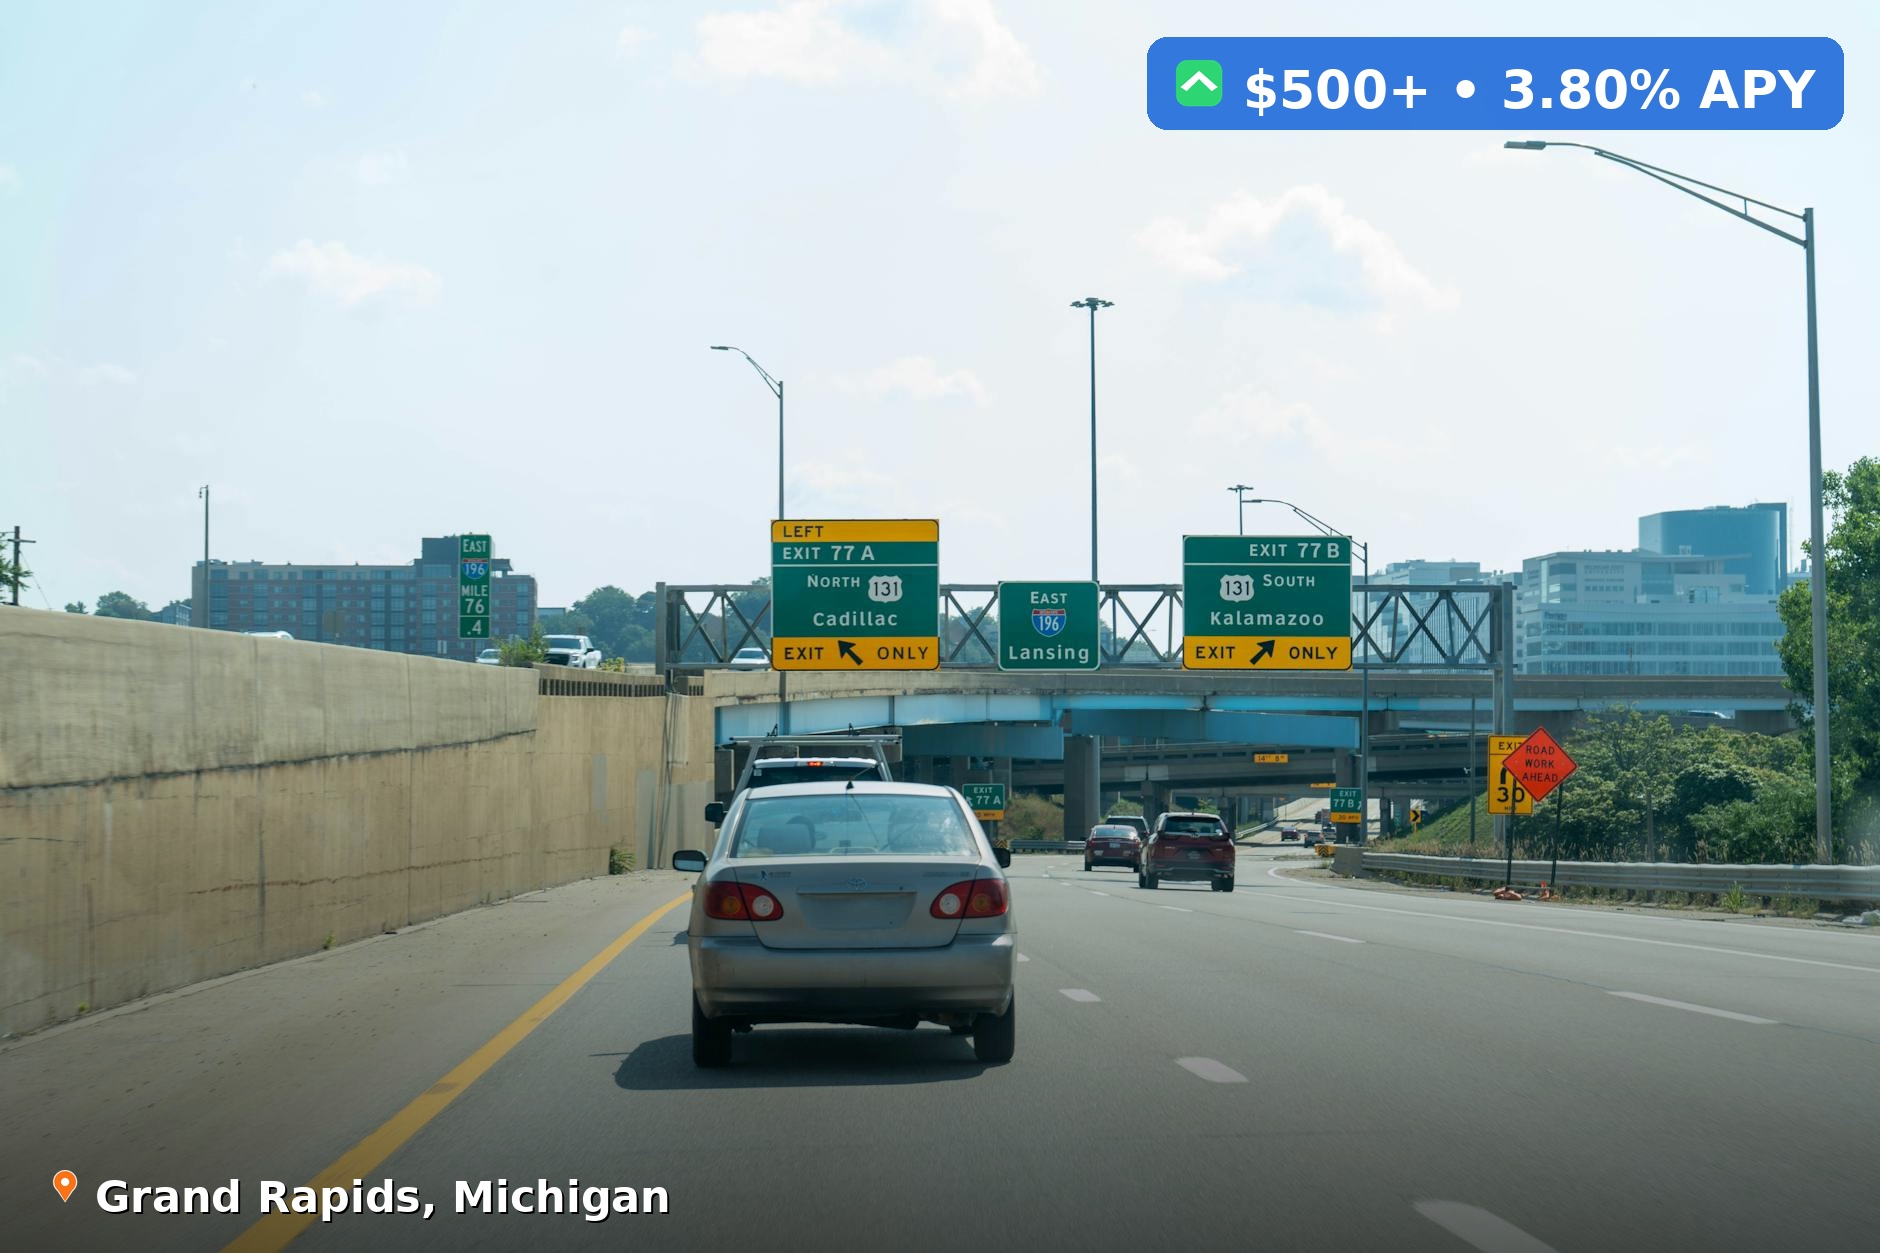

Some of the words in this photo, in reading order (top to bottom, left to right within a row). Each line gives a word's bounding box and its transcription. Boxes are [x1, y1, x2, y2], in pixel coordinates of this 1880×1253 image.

[783, 525, 824, 538] LEFT
[462, 538, 487, 553] EAST
[782, 546, 821, 560] EXIT
[830, 545, 855, 561] 77
[860, 545, 875, 561] A
[1249, 543, 1288, 557] EXIT
[1297, 542, 1322, 559] 77
[1327, 542, 1340, 559] B
[465, 563, 486, 578] 196
[461, 584, 488, 597] MILE
[807, 573, 860, 588] NORTH
[872, 581, 899, 597] 131
[1225, 580, 1250, 596] 131
[1263, 573, 1315, 587] SOUTH
[1030, 591, 1068, 604] EAST
[464, 598, 485, 614] 76
[813, 610, 898, 627] Cadillac
[1038, 614, 1060, 632] 196
[1210, 610, 1324, 626] Kalamazoo
[784, 646, 824, 660] EXIT
[877, 646, 929, 660] ONLY
[1009, 644, 1089, 664] Lansing
[1195, 645, 1236, 659] EXIT
[1289, 645, 1338, 660] ONLY
[1525, 745, 1555, 755] ROAD
[1525, 759, 1554, 768] WORK
[1522, 773, 1558, 783] AHEAD
[973, 786, 993, 794] EXIT
[1339, 790, 1357, 798] EXIT
[1497, 786, 1525, 803] 30
[976, 795, 990, 805] 77
[993, 795, 1001, 805] A
[1333, 798, 1346, 808] 77
